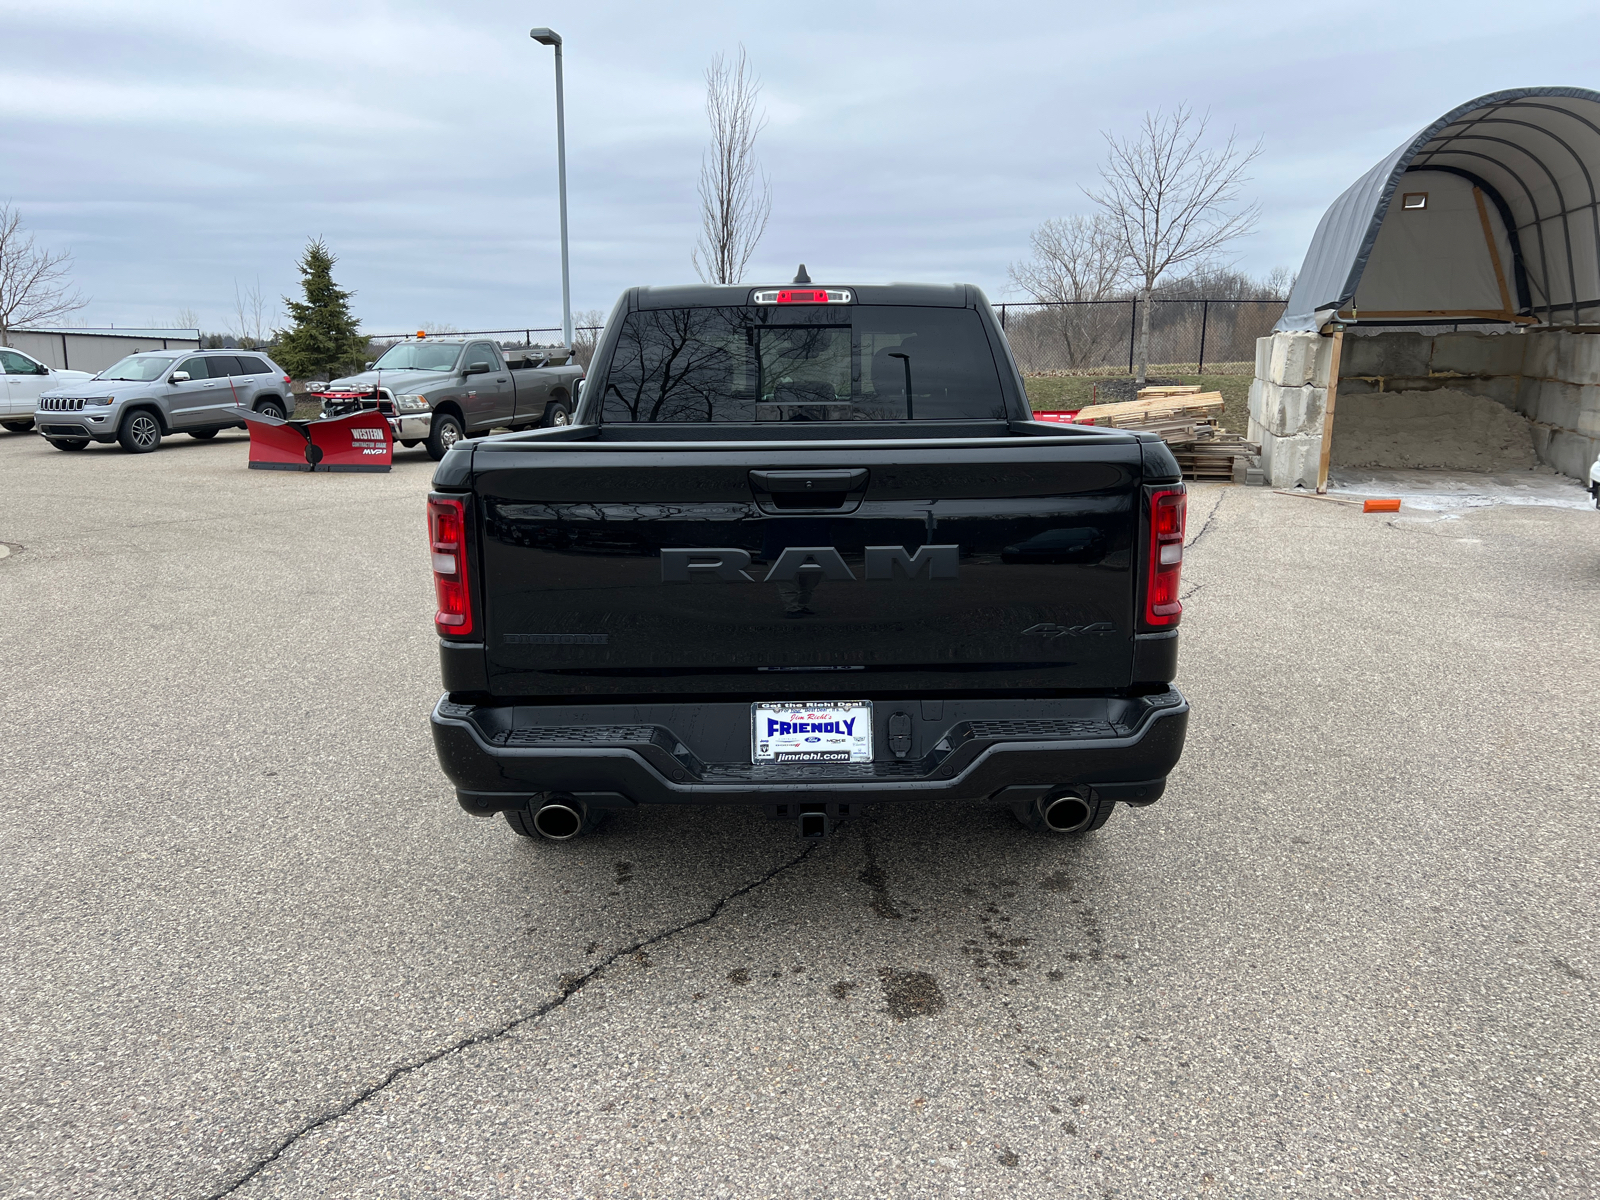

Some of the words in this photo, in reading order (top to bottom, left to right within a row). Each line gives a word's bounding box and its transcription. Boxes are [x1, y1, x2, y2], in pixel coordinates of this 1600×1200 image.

[350, 428, 384, 440] WESTERN
[659, 544, 960, 583] RAM
[789, 713, 805, 722] Jim
[767, 716, 856, 738] FRIENDLY
[777, 752, 849, 762] jimriehl.com
